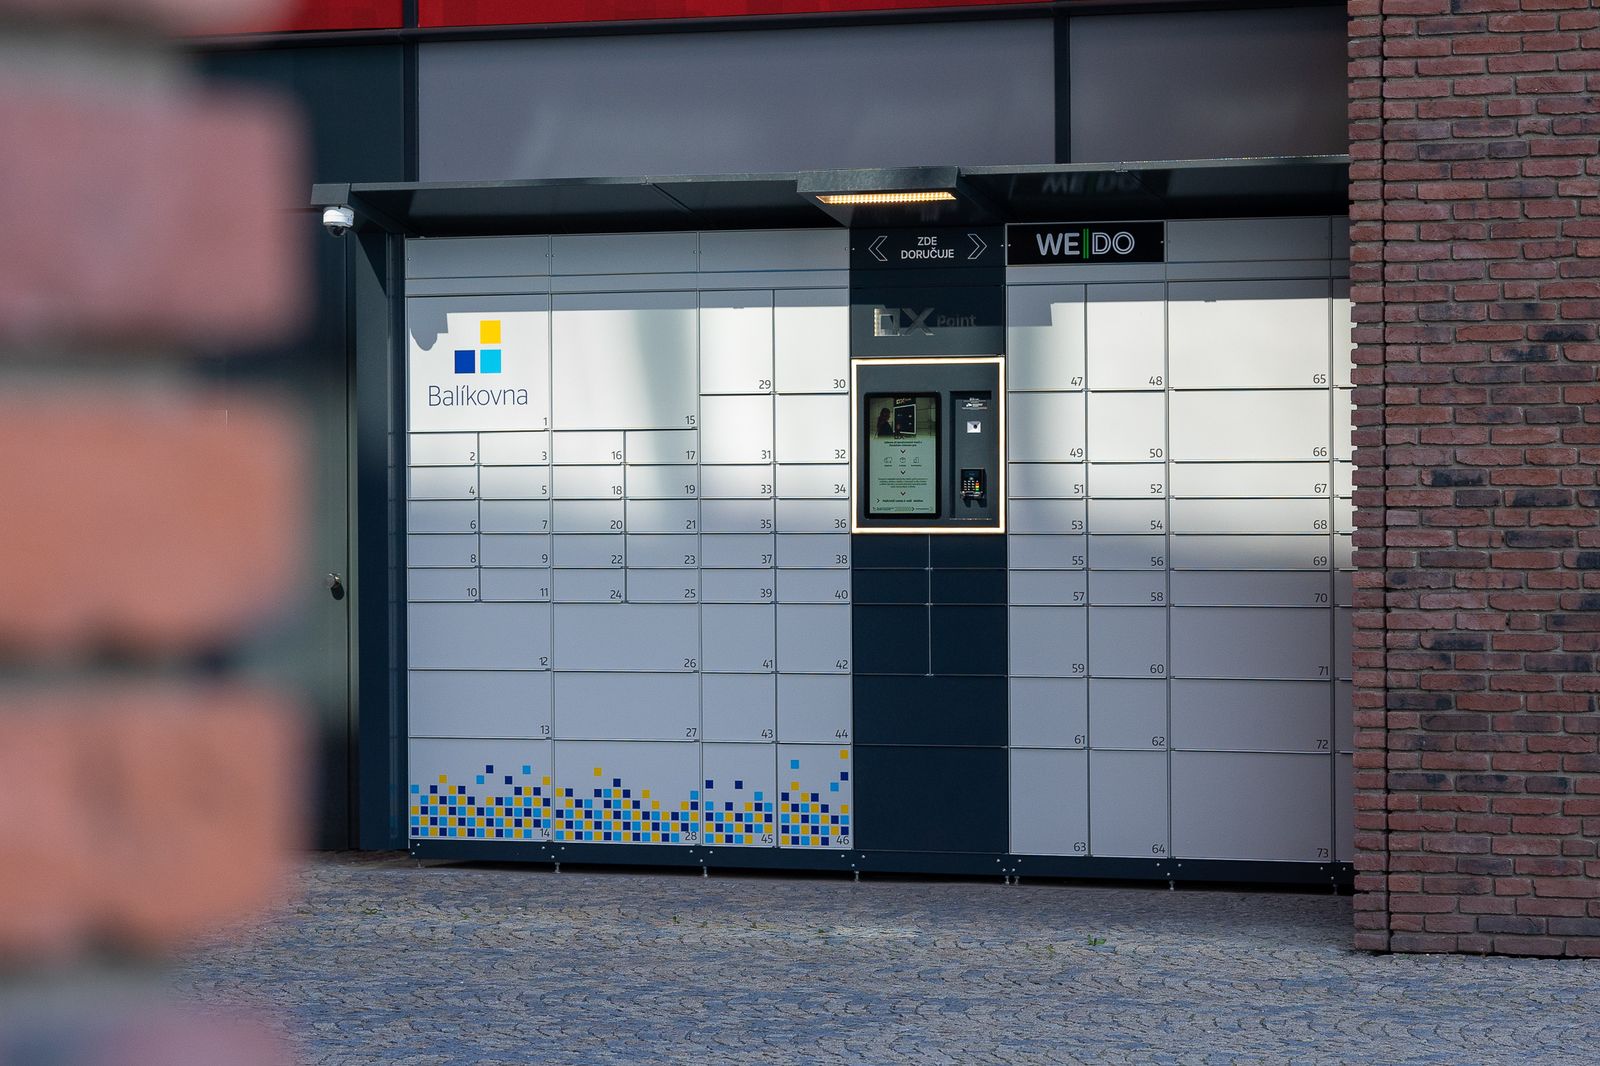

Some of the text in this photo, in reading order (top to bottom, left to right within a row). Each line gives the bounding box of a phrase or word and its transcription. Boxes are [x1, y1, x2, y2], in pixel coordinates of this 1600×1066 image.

[917, 236, 938, 246] ZDE
[900, 247, 955, 260] DORUČUJE
[833, 378, 846, 389] 30
[1070, 376, 1083, 386] 47
[1148, 375, 1163, 386] 48
[1313, 373, 1327, 384] 65
[758, 379, 772, 390] 29
[428, 384, 528, 406] Balíkovna
[543, 417, 548, 426] 1
[685, 415, 696, 425] 15
[469, 451, 476, 461] 2
[542, 451, 548, 461] 3
[611, 450, 623, 460] 16
[686, 450, 696, 460] 17
[761, 449, 771, 460] 31
[834, 449, 846, 459] 32
[1069, 447, 1084, 458] 49
[1149, 448, 1163, 458] 50
[1312, 446, 1328, 457] 66
[468, 486, 475, 496] 4
[541, 485, 547, 495] 5
[611, 485, 623, 495] 18
[684, 484, 696, 494] 19
[760, 484, 772, 494] 33
[834, 484, 846, 494] 34
[1074, 484, 1084, 494] 51
[1150, 483, 1163, 494] 52
[1314, 483, 1327, 494] 67
[470, 519, 477, 530] 6
[542, 519, 548, 530] 7
[610, 519, 623, 530] 20
[686, 519, 696, 530] 21
[760, 519, 772, 529] 35
[834, 518, 847, 529] 36
[1071, 520, 1084, 530] 53
[1150, 520, 1163, 530] 54
[1313, 519, 1328, 530] 68
[470, 553, 477, 564] 8
[541, 553, 548, 564] 9
[611, 554, 623, 565] 22
[684, 554, 696, 565] 23
[761, 554, 773, 564] 37
[835, 554, 848, 564] 38
[1072, 555, 1084, 566] 55
[1150, 556, 1164, 567] 56
[1313, 556, 1328, 567] 69
[466, 587, 478, 597] 10
[540, 587, 549, 597] 11
[610, 589, 622, 600] 24
[684, 588, 696, 599] 25
[760, 588, 773, 598] 39
[834, 589, 849, 600] 40
[1073, 591, 1085, 602] 57
[1150, 591, 1164, 602] 58
[1314, 592, 1328, 603] 70
[539, 656, 548, 666] 12
[684, 658, 697, 668] 26
[762, 659, 773, 669] 41
[835, 659, 848, 670] 42
[1072, 663, 1085, 674] 59
[1149, 663, 1165, 674] 60
[1318, 665, 1329, 676] 71
[540, 725, 550, 735] 13
[686, 727, 697, 738] 27
[761, 728, 774, 739] 43
[835, 729, 849, 739] 44
[1074, 734, 1086, 745] 61
[1151, 736, 1165, 747] 62
[1316, 739, 1329, 750] 72
[540, 828, 550, 838] 14
[684, 831, 698, 841] 28
[760, 834, 774, 844] 45
[836, 835, 850, 845] 46
[1073, 841, 1087, 852] 63
[1151, 843, 1166, 854] 64
[1317, 847, 1329, 858] 73
